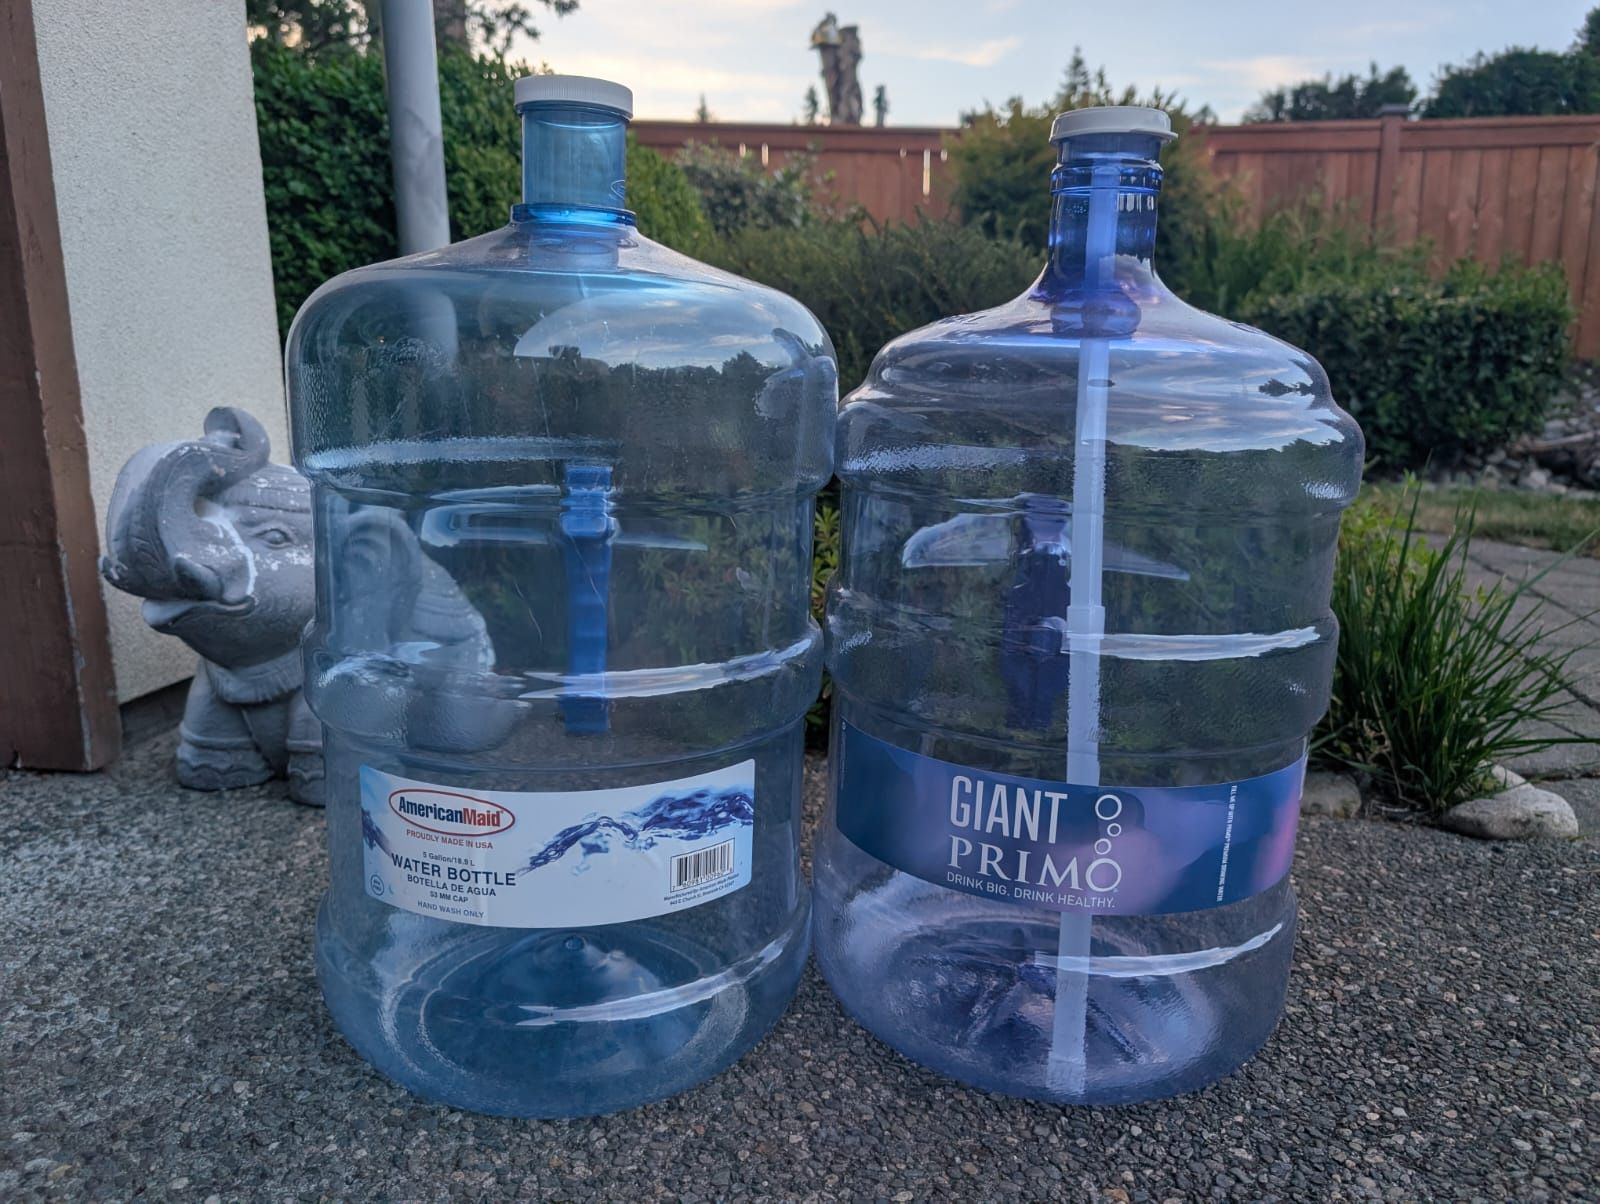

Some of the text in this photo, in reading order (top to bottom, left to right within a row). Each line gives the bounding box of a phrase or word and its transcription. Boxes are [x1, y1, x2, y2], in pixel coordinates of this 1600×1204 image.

[398, 796, 501, 827] AmericanMaid
[950, 775, 1068, 844] GIANT
[406, 829, 493, 849] PROUDLY MADE IN USA
[391, 853, 516, 887] WATER BOTTLE
[947, 834, 1122, 893] PRIMO
[407, 874, 497, 897] BOTELLA DE AGUA
[439, 892, 451, 901] MM
[452, 894, 469, 903] CAP
[947, 871, 1116, 909] DRINK BIG. DRINK HEALTHY.
[417, 900, 485, 919] HAND WASH ONLY
